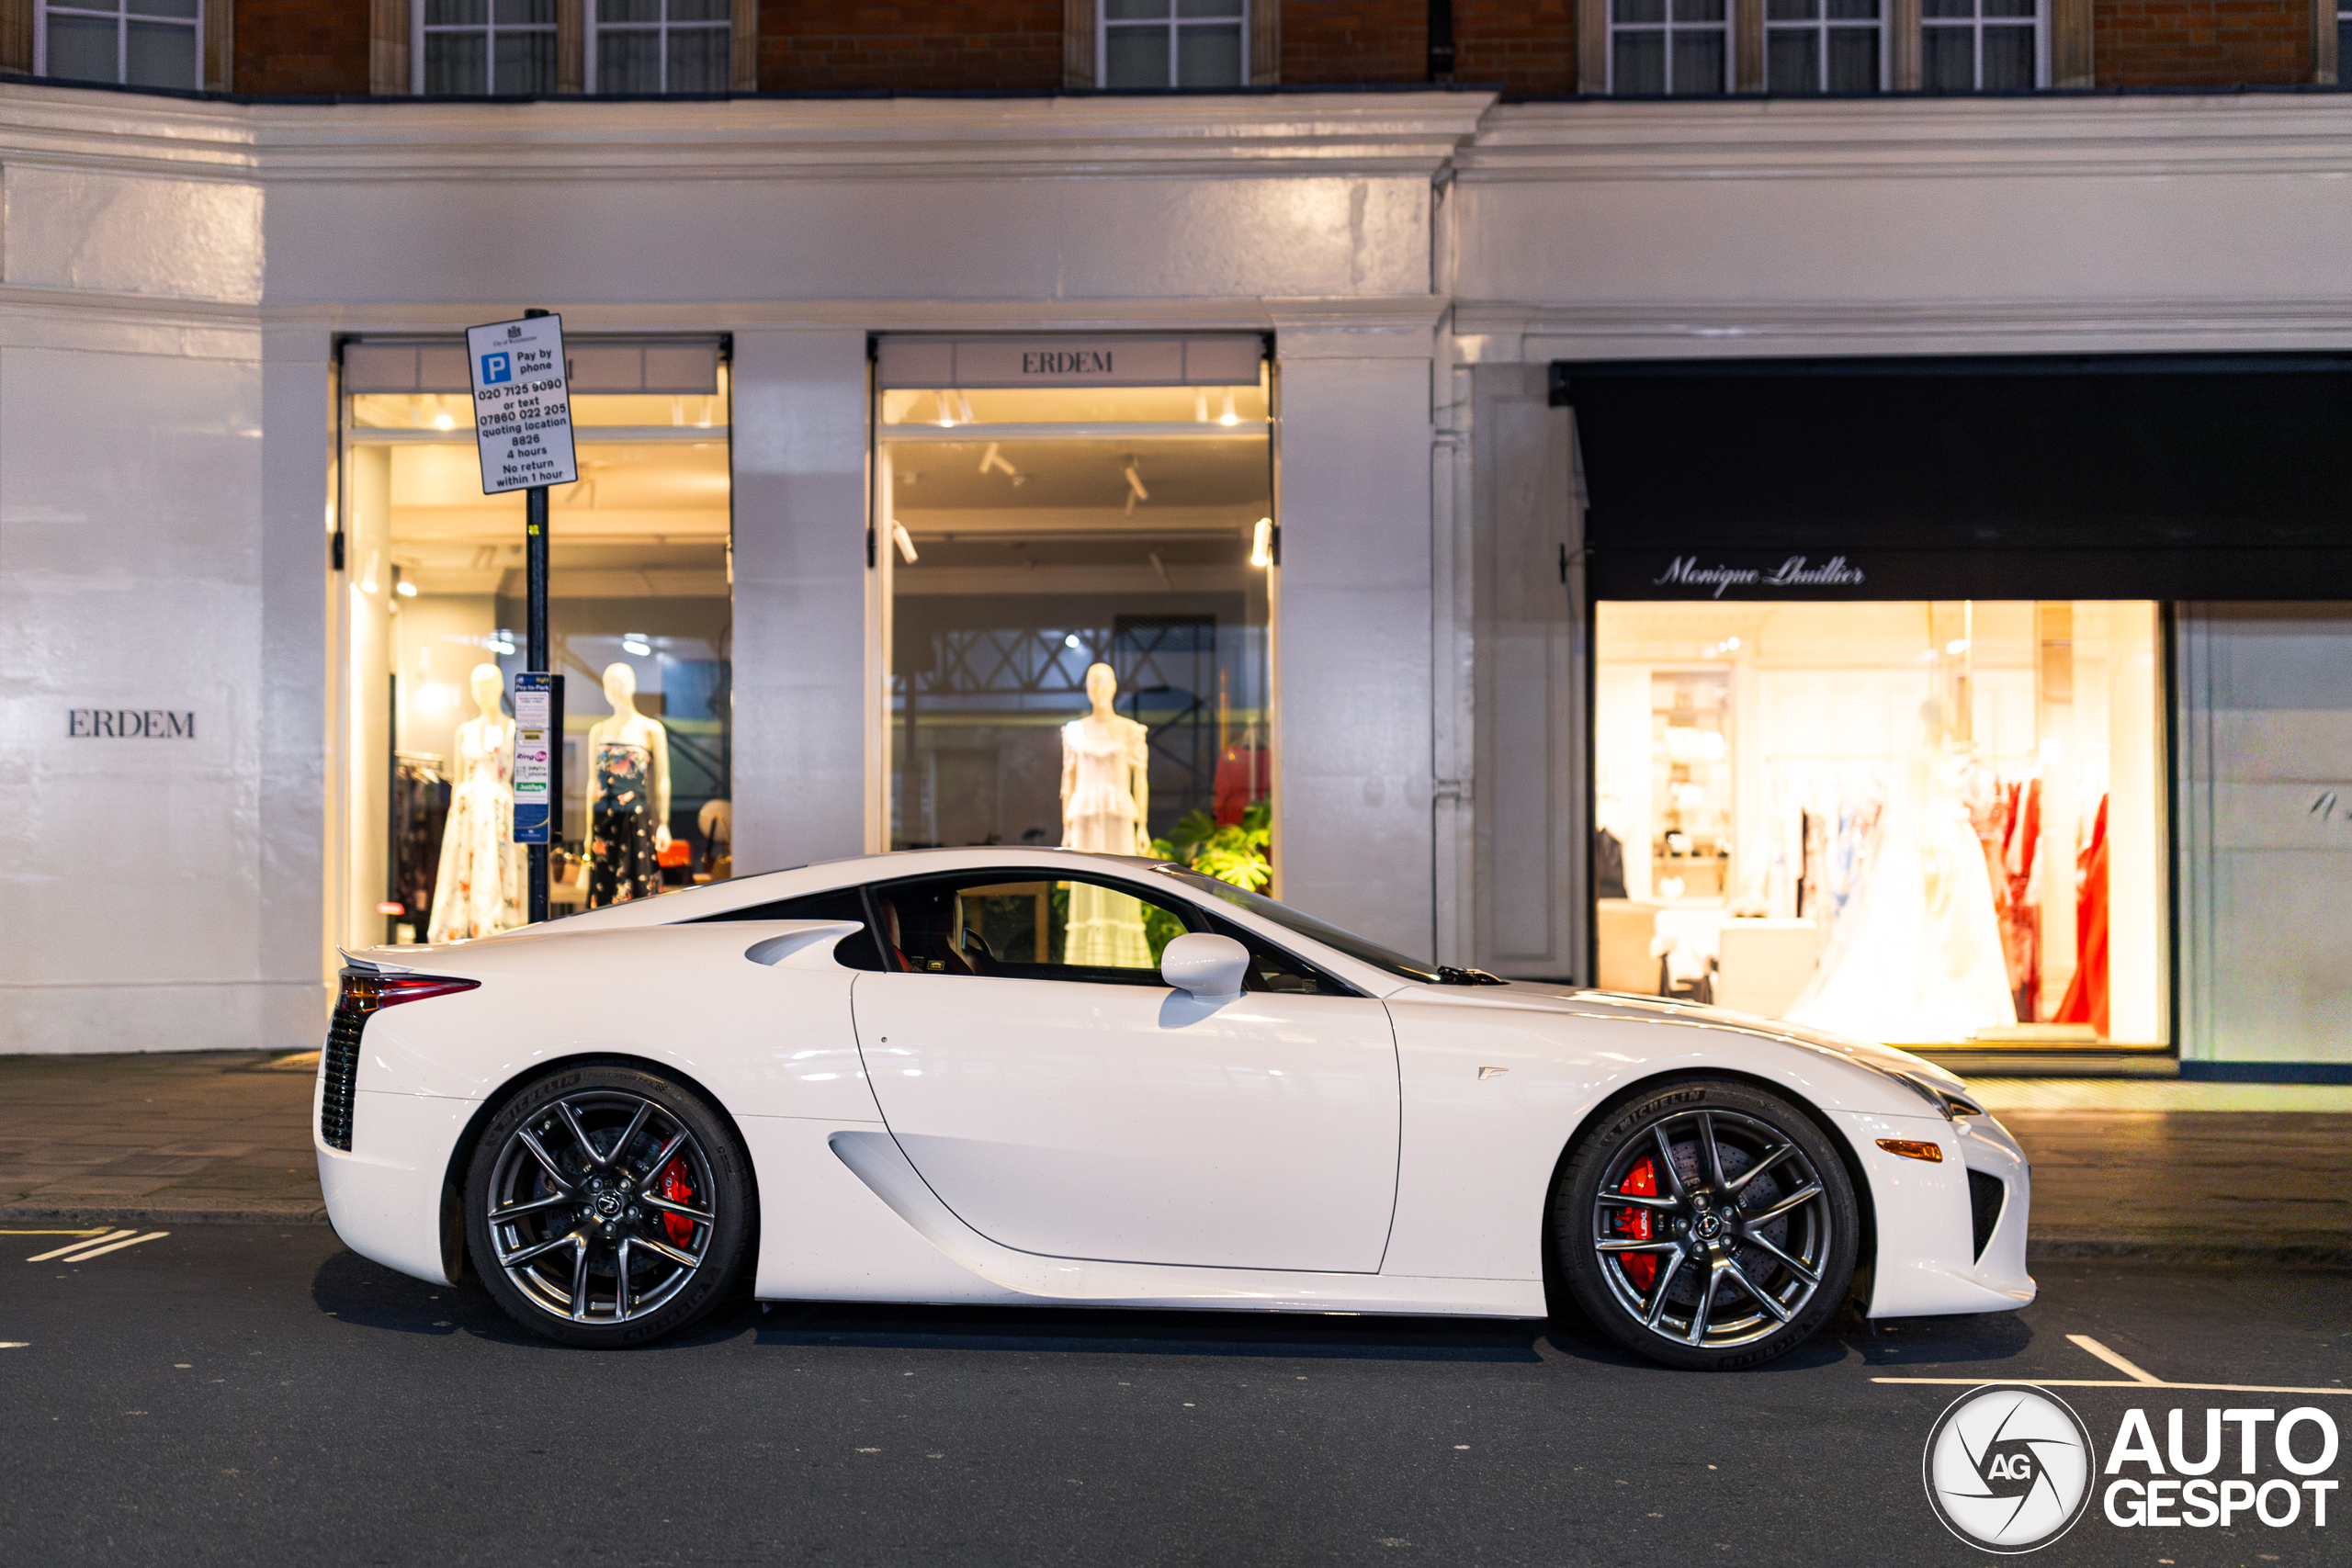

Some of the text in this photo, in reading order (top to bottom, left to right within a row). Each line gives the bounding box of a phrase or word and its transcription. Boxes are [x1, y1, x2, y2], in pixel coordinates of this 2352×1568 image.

[516, 349, 552, 361] Pay by
[1023, 351, 1113, 373] ERDEM
[488, 355, 505, 381] P
[520, 361, 552, 376] phone
[479, 378, 562, 400] 020 7125 9090
[503, 396, 539, 410] or text
[480, 402, 566, 426] 07860 022 205
[482, 417, 567, 438] quoting location
[512, 433, 540, 446] 8826
[507, 446, 548, 458] 4 hours
[503, 459, 554, 474] No return
[496, 470, 563, 487] within 1 hour
[1654, 555, 1760, 599] Monique
[68, 709, 197, 739] ERDEM
